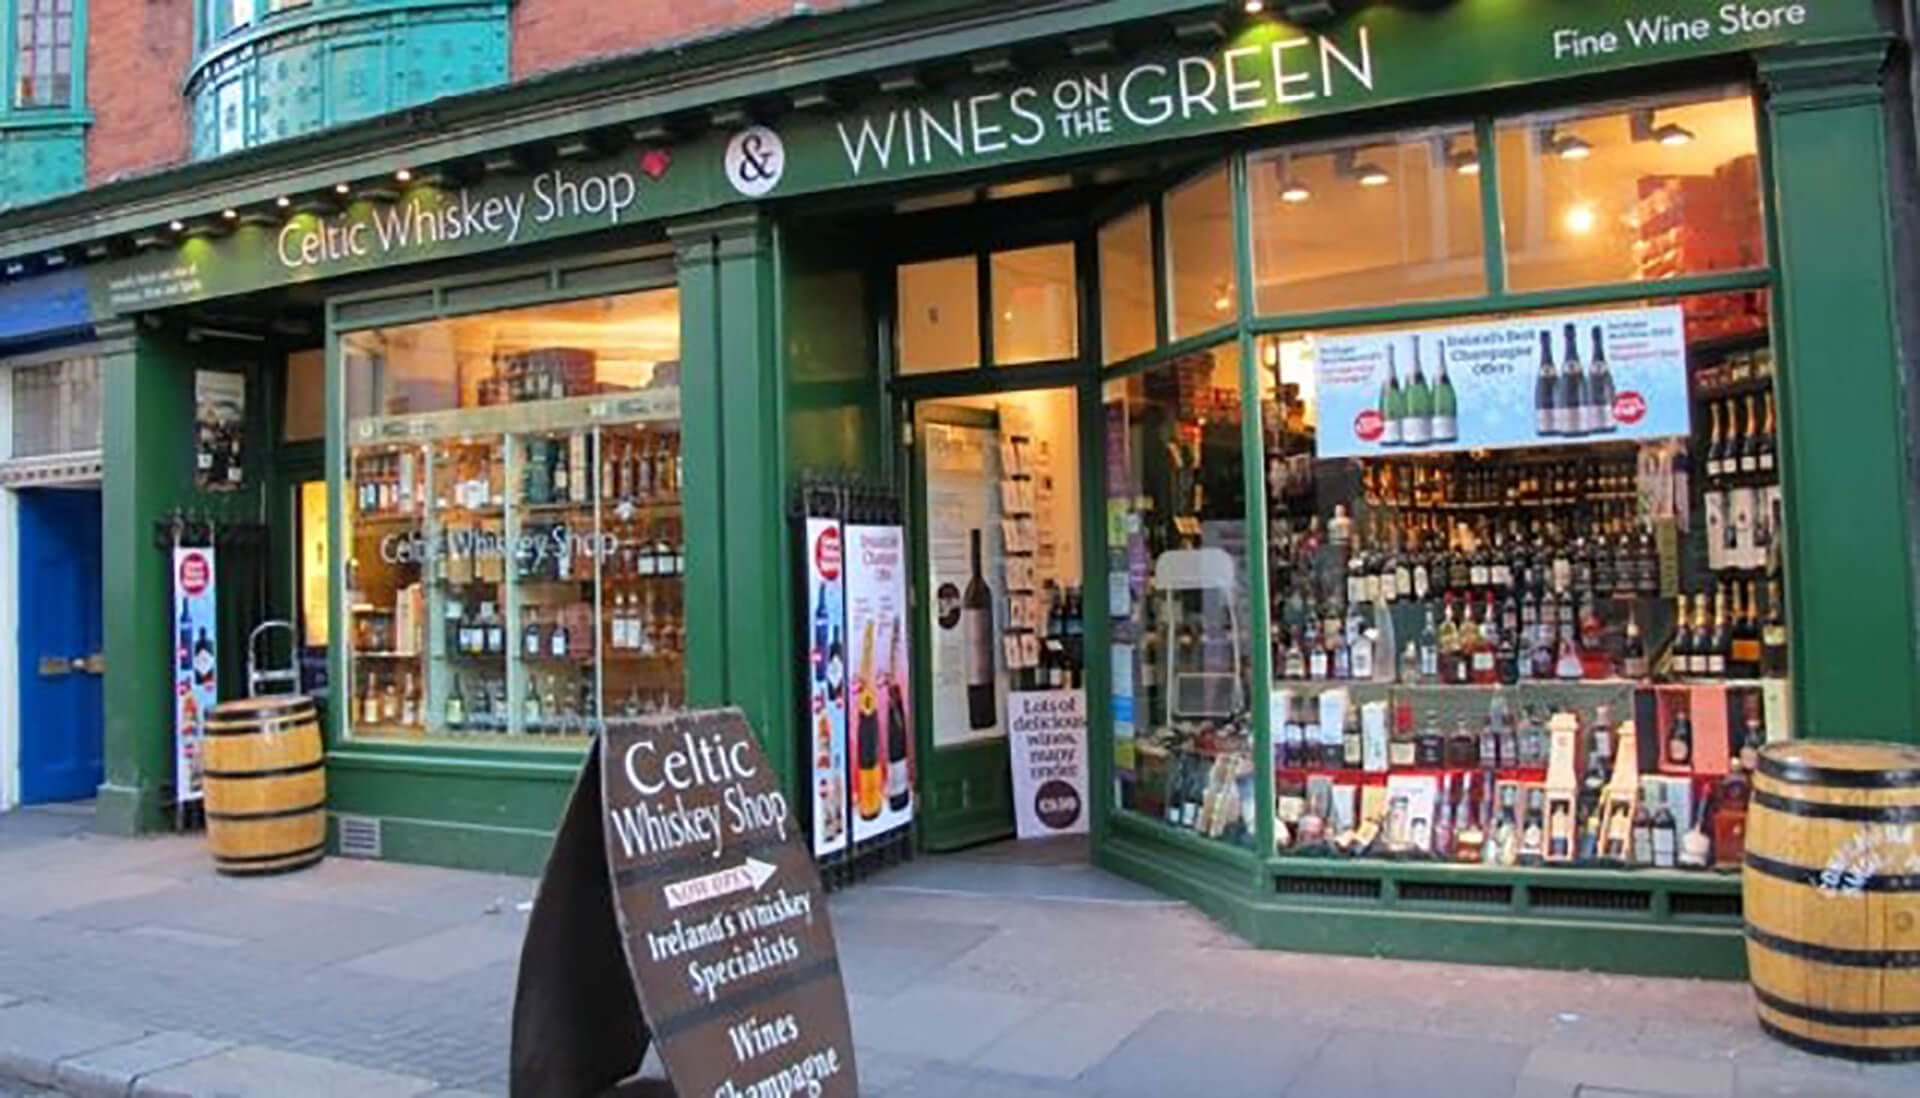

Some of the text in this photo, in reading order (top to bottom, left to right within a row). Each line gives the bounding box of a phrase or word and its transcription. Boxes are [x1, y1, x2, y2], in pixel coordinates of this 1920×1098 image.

[1553, 2, 1807, 60] Fine Wine Store
[1053, 74, 1109, 110] ON
[1119, 26, 1374, 125] GREEN
[837, 86, 1045, 175] WINES
[1056, 106, 1112, 138] THE
[737, 134, 776, 183] &
[278, 169, 636, 269] Celtic Whiskey Shop
[380, 525, 618, 572] Celt Whisey Shop
[625, 733, 756, 795] Celtic
[611, 784, 787, 857] Whiskey Shop
[648, 911, 736, 961] Ireland's
[688, 935, 798, 1001] Specialists
[728, 1013, 798, 1062] Wines
